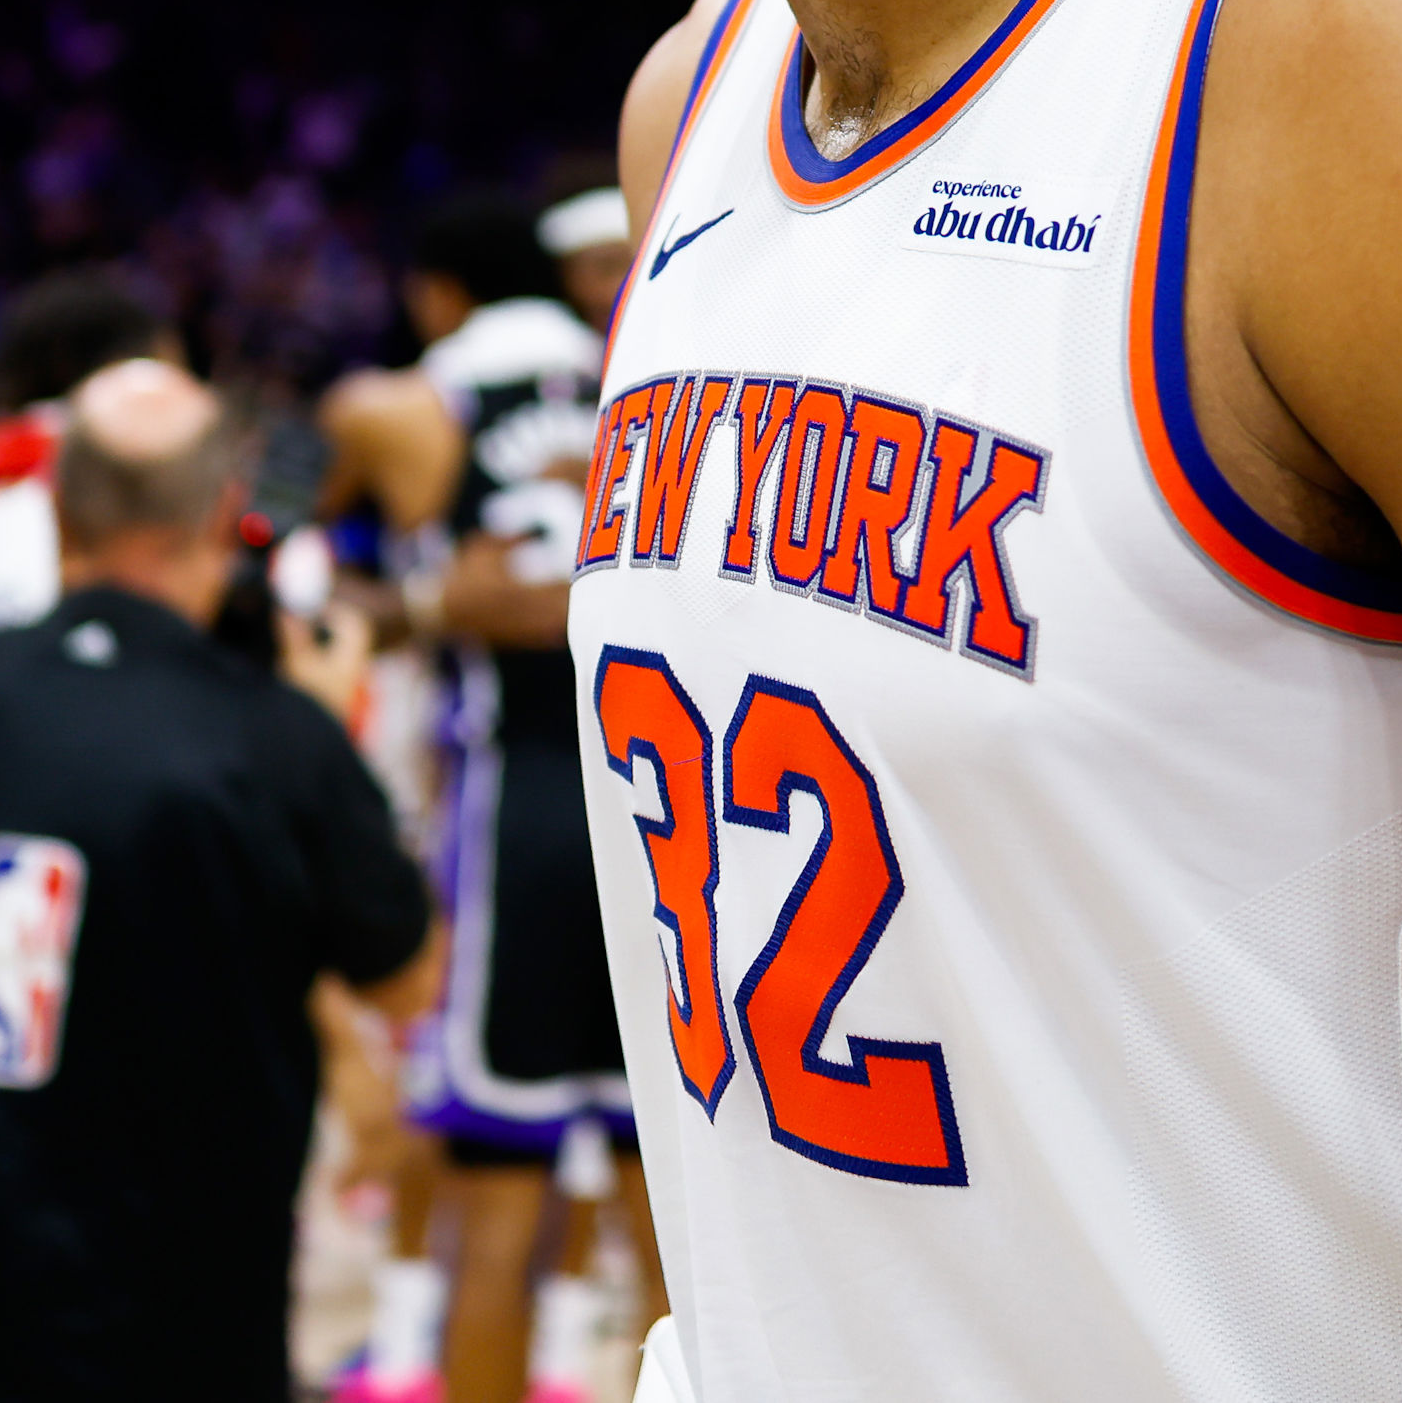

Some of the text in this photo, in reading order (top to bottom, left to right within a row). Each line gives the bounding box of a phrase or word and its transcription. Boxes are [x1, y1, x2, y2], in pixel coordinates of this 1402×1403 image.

[913, 201, 1102, 253] abu dhabi
[932, 180, 1022, 199] experience
[718, 370, 1053, 685] YORK
[594, 643, 970, 1186] 32
